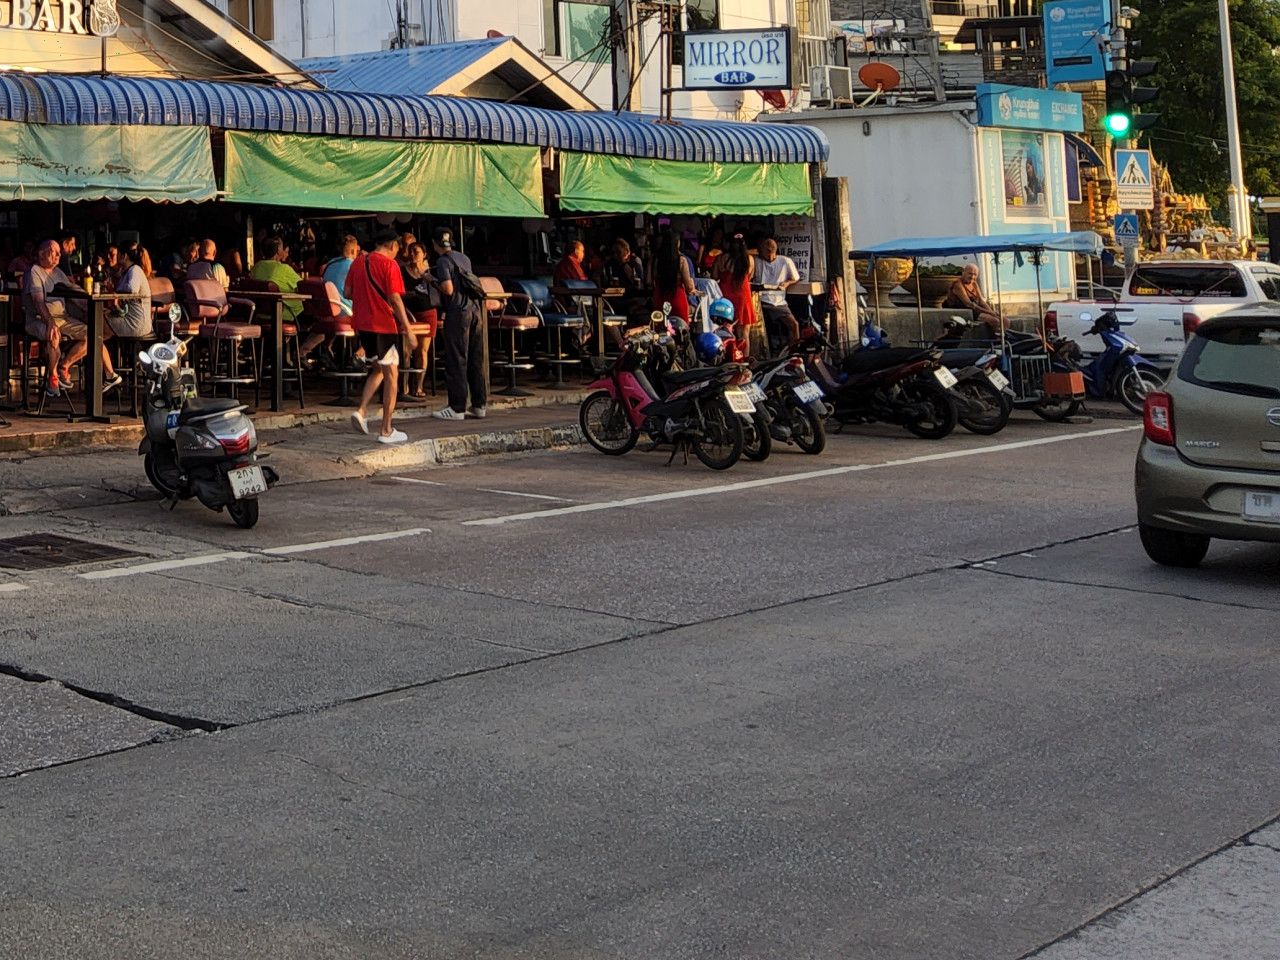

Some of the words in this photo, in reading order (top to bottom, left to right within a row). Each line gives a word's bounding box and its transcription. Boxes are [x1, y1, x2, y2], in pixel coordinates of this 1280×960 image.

[688, 38, 782, 67] MIRROR
[720, 72, 748, 83] BAR
[794, 233, 811, 244] Hours
[787, 248, 809, 257] Beers
